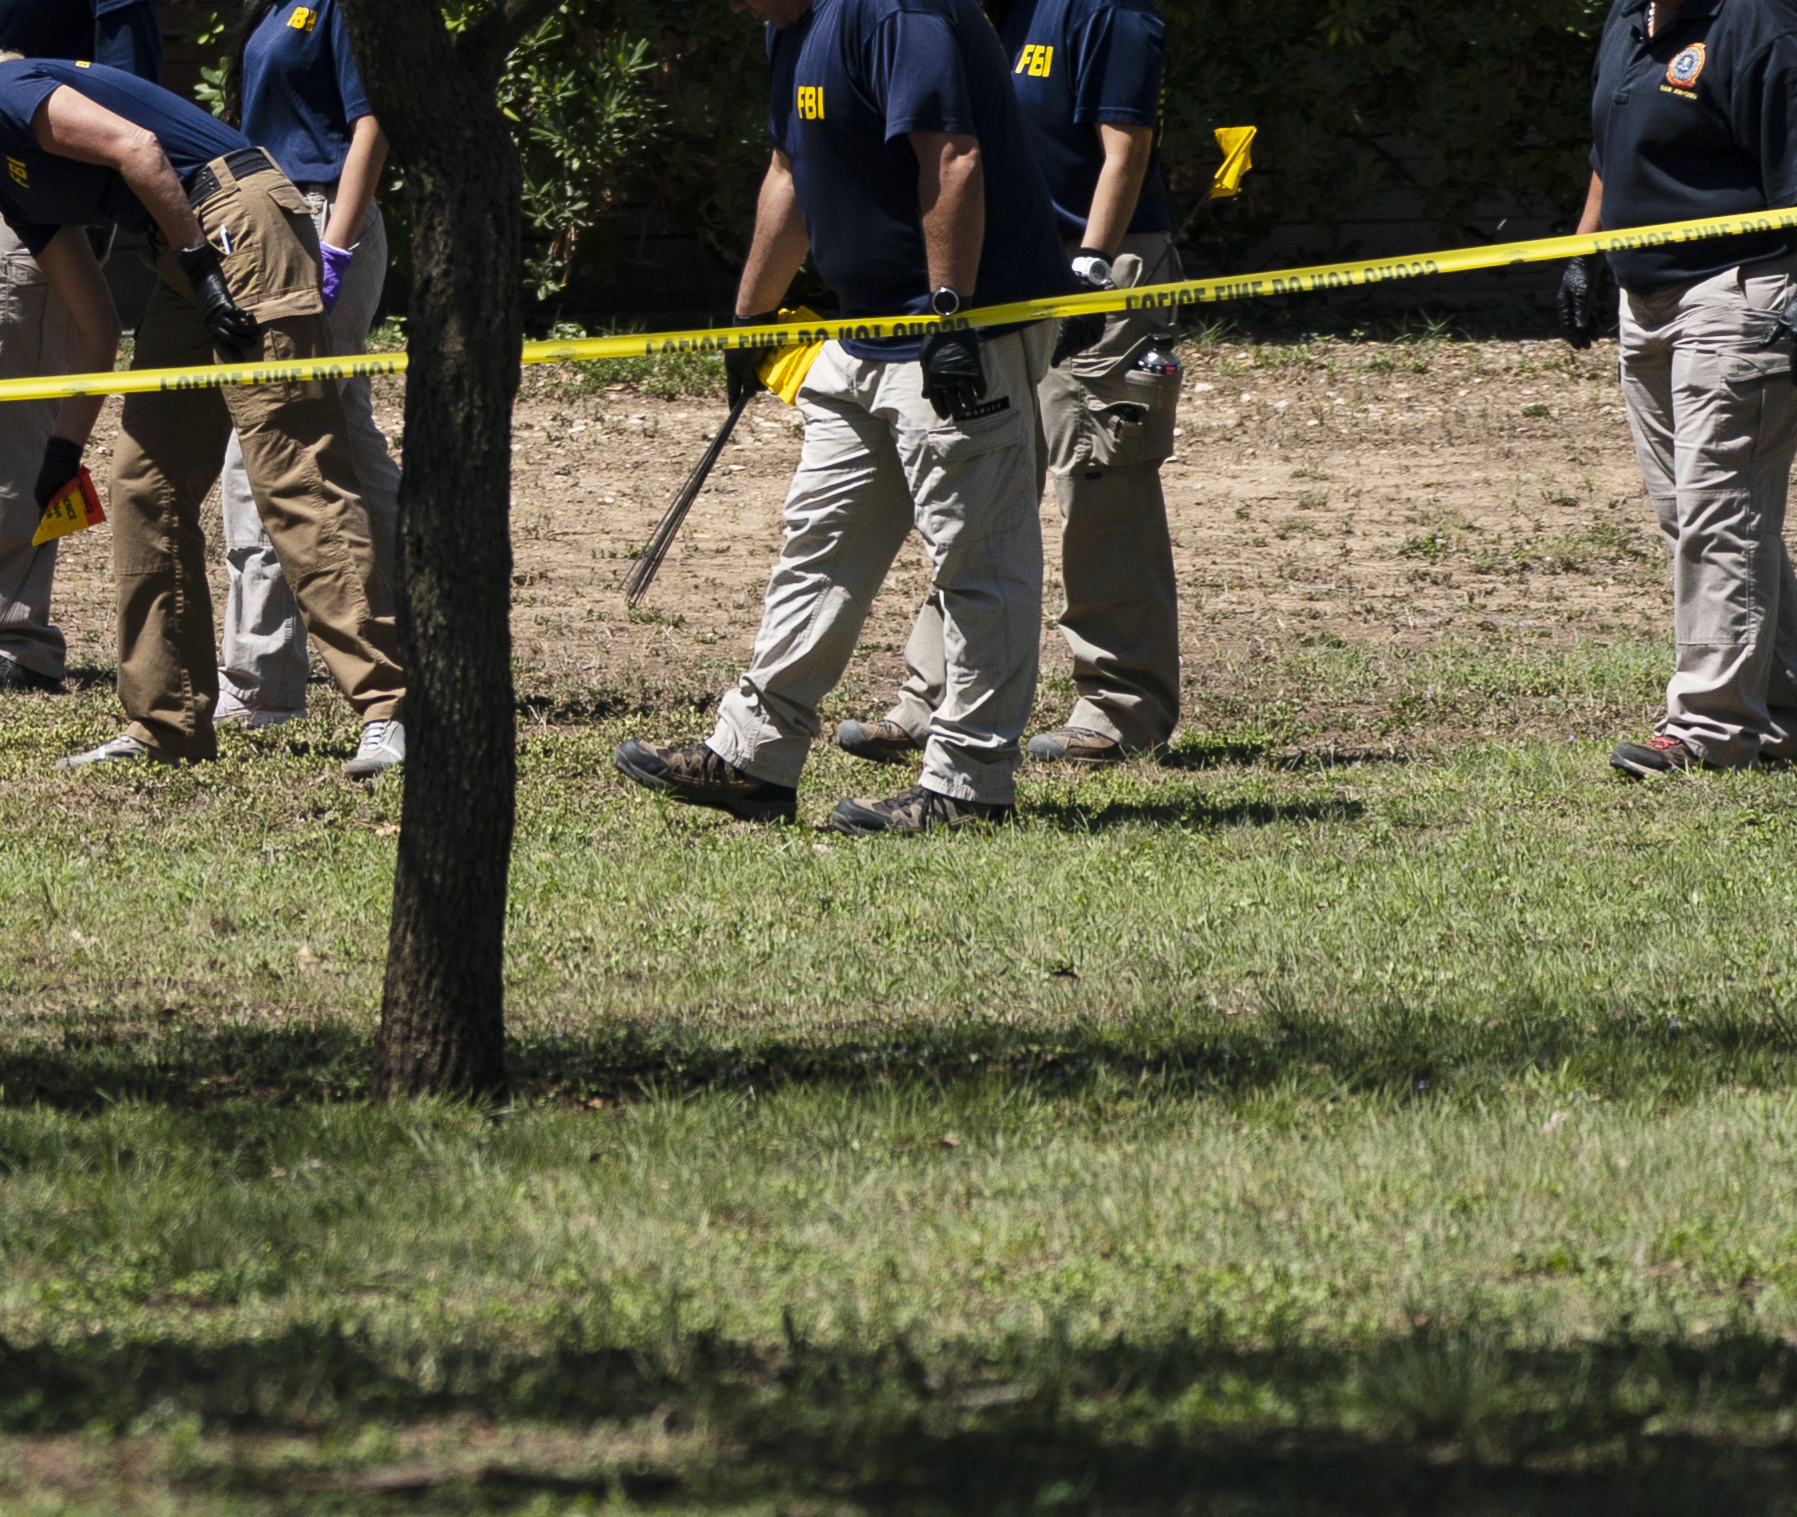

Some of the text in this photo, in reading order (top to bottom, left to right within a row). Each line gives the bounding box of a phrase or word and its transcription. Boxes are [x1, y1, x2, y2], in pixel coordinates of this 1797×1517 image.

[1014, 43, 1055, 78] FBI
[797, 85, 826, 121] FBI
[6, 156, 30, 189] FBI
